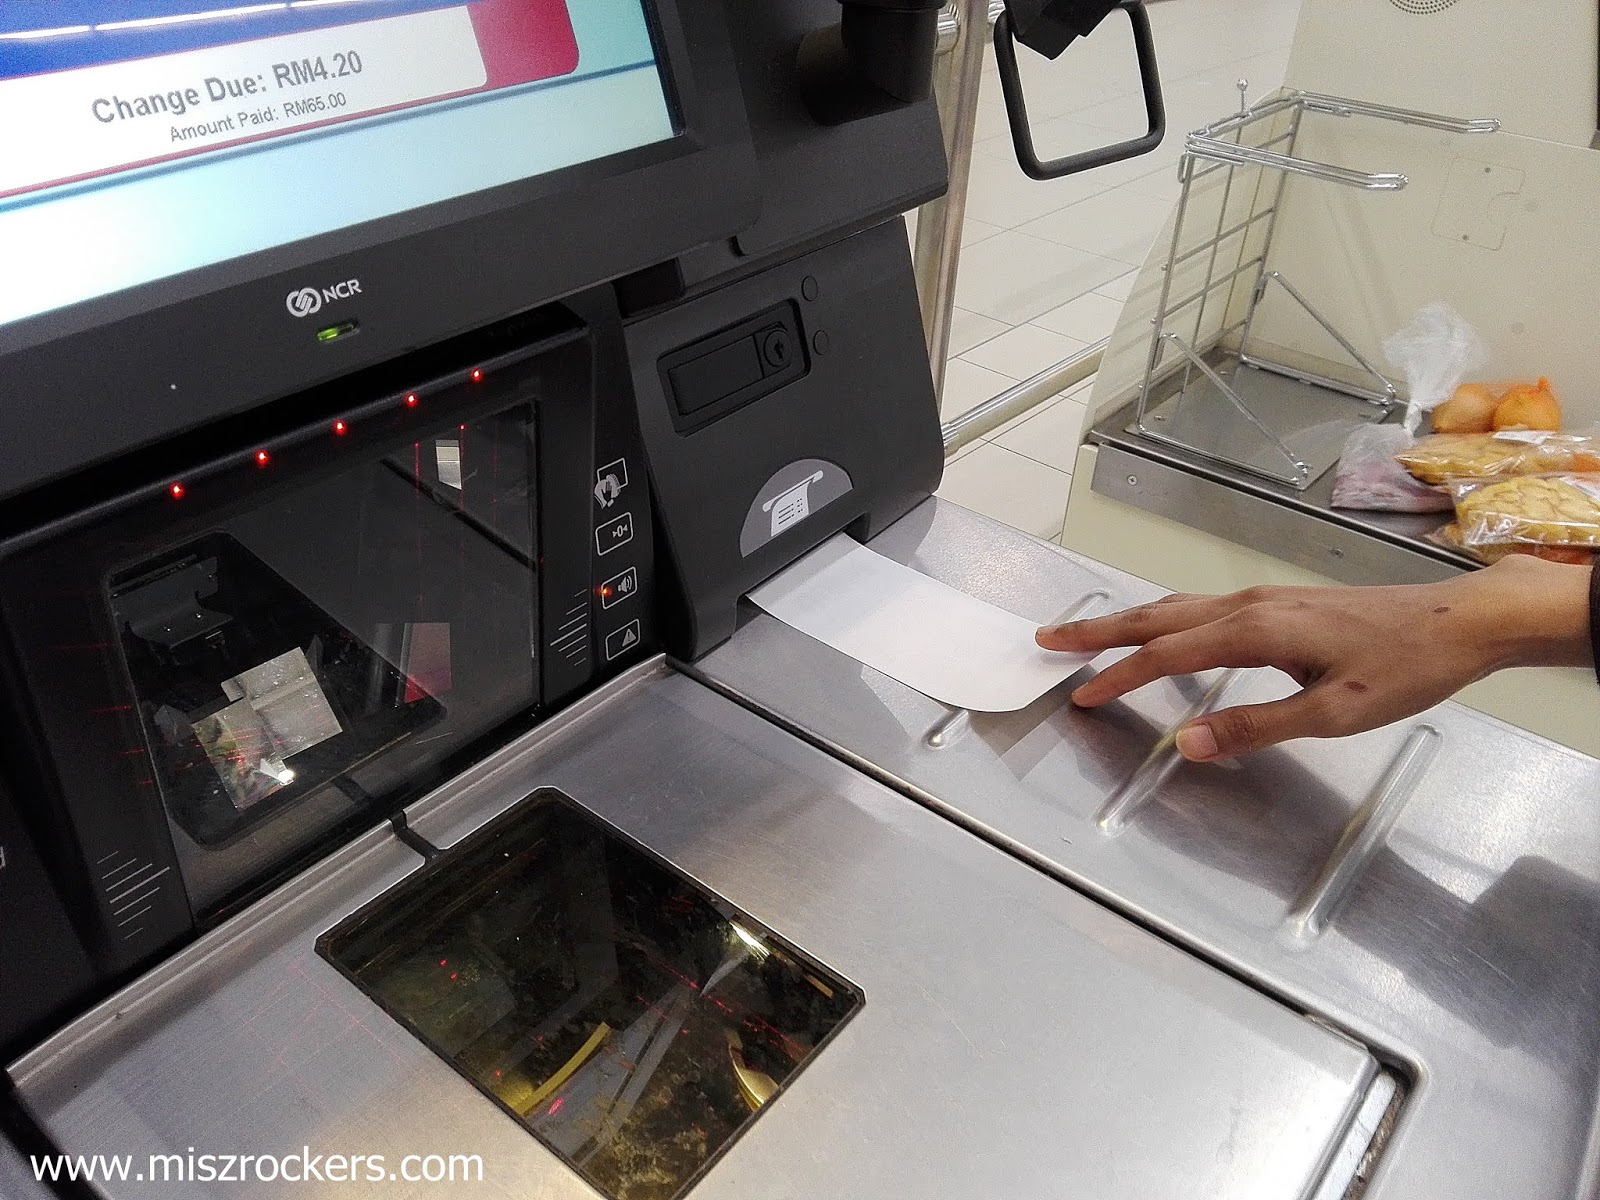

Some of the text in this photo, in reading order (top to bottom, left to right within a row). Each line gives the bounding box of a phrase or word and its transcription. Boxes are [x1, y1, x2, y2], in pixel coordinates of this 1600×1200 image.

[91, 49, 363, 124] Change Due: RM4.20
[170, 91, 348, 142] Amount Paid: RM65.00
[322, 279, 362, 303] NCR
